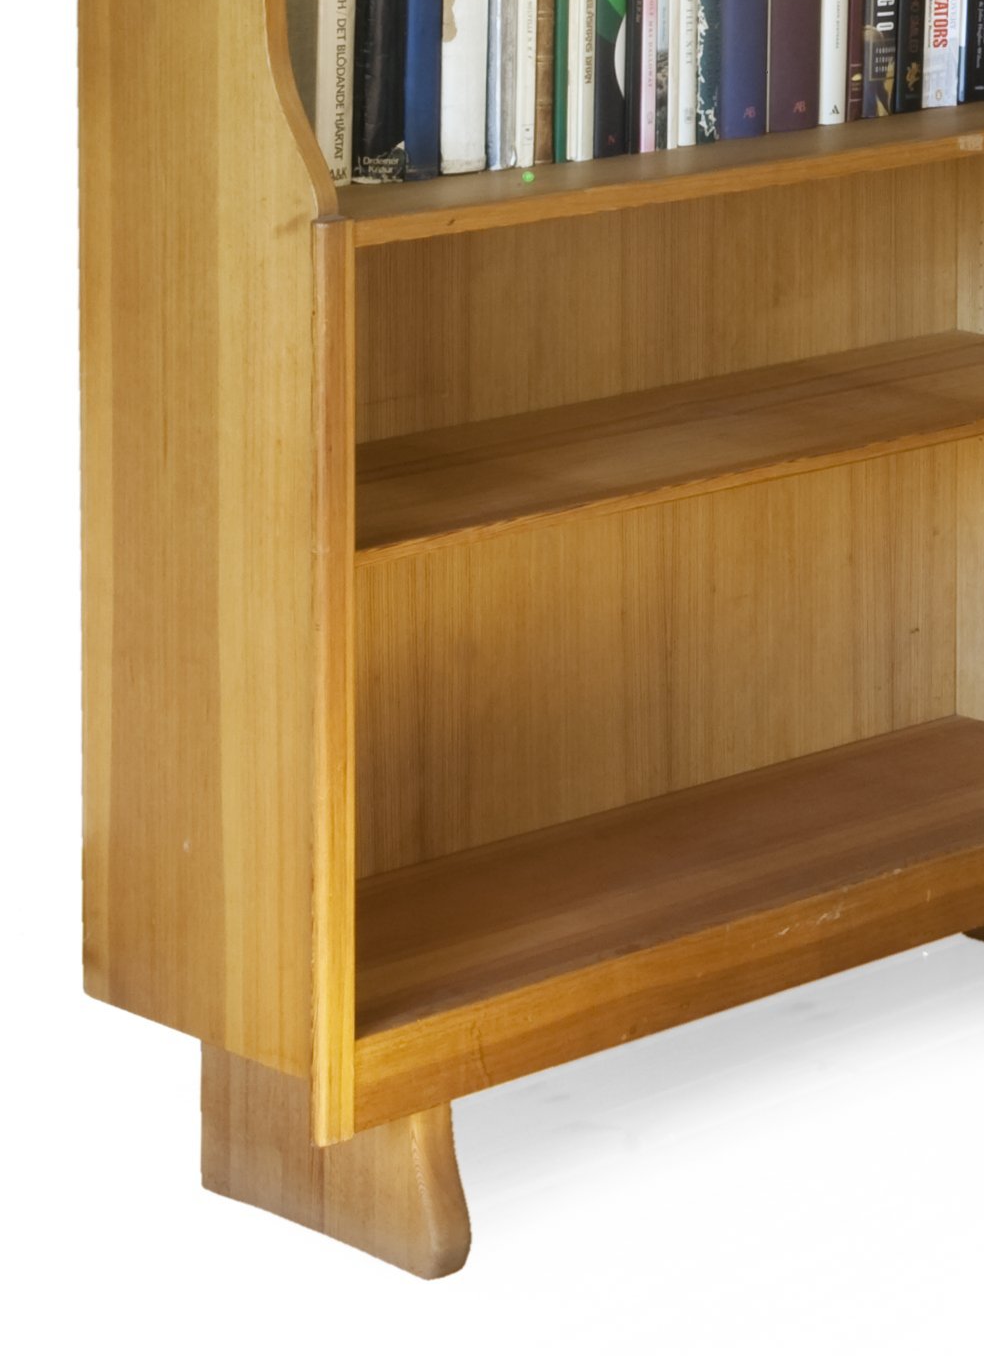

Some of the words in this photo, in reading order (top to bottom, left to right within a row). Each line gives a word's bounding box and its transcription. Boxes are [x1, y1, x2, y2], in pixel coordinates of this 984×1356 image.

[336, 17, 348, 40] DET
[335, 43, 349, 110] BLÖDANDE
[334, 112, 347, 160] HJÄRTAT
